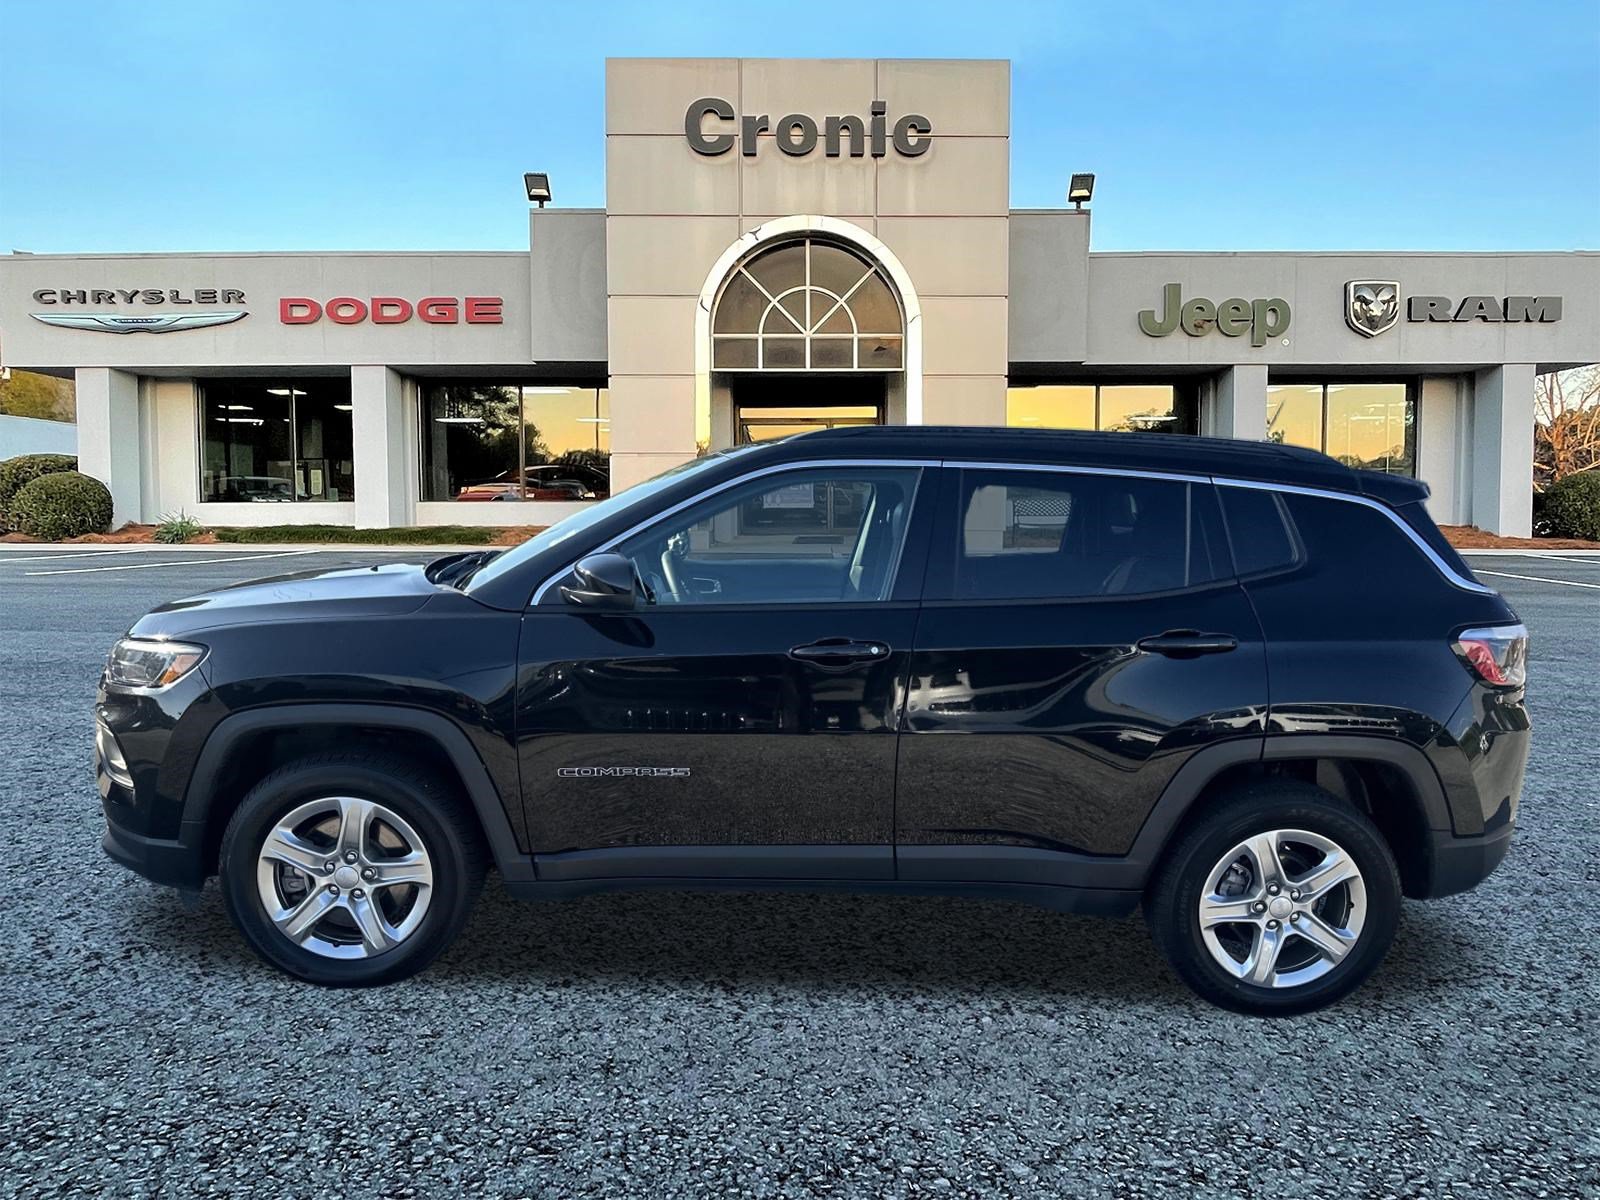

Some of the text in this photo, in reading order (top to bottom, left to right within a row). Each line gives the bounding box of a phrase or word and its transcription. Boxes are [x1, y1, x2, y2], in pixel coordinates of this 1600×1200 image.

[684, 97, 933, 158] Cronic
[32, 288, 247, 304] CHRYSLER
[1407, 296, 1563, 323] RAM
[280, 297, 504, 324] DODGE
[1138, 283, 1292, 347] Jeep
[557, 767, 691, 778] COMPASS
